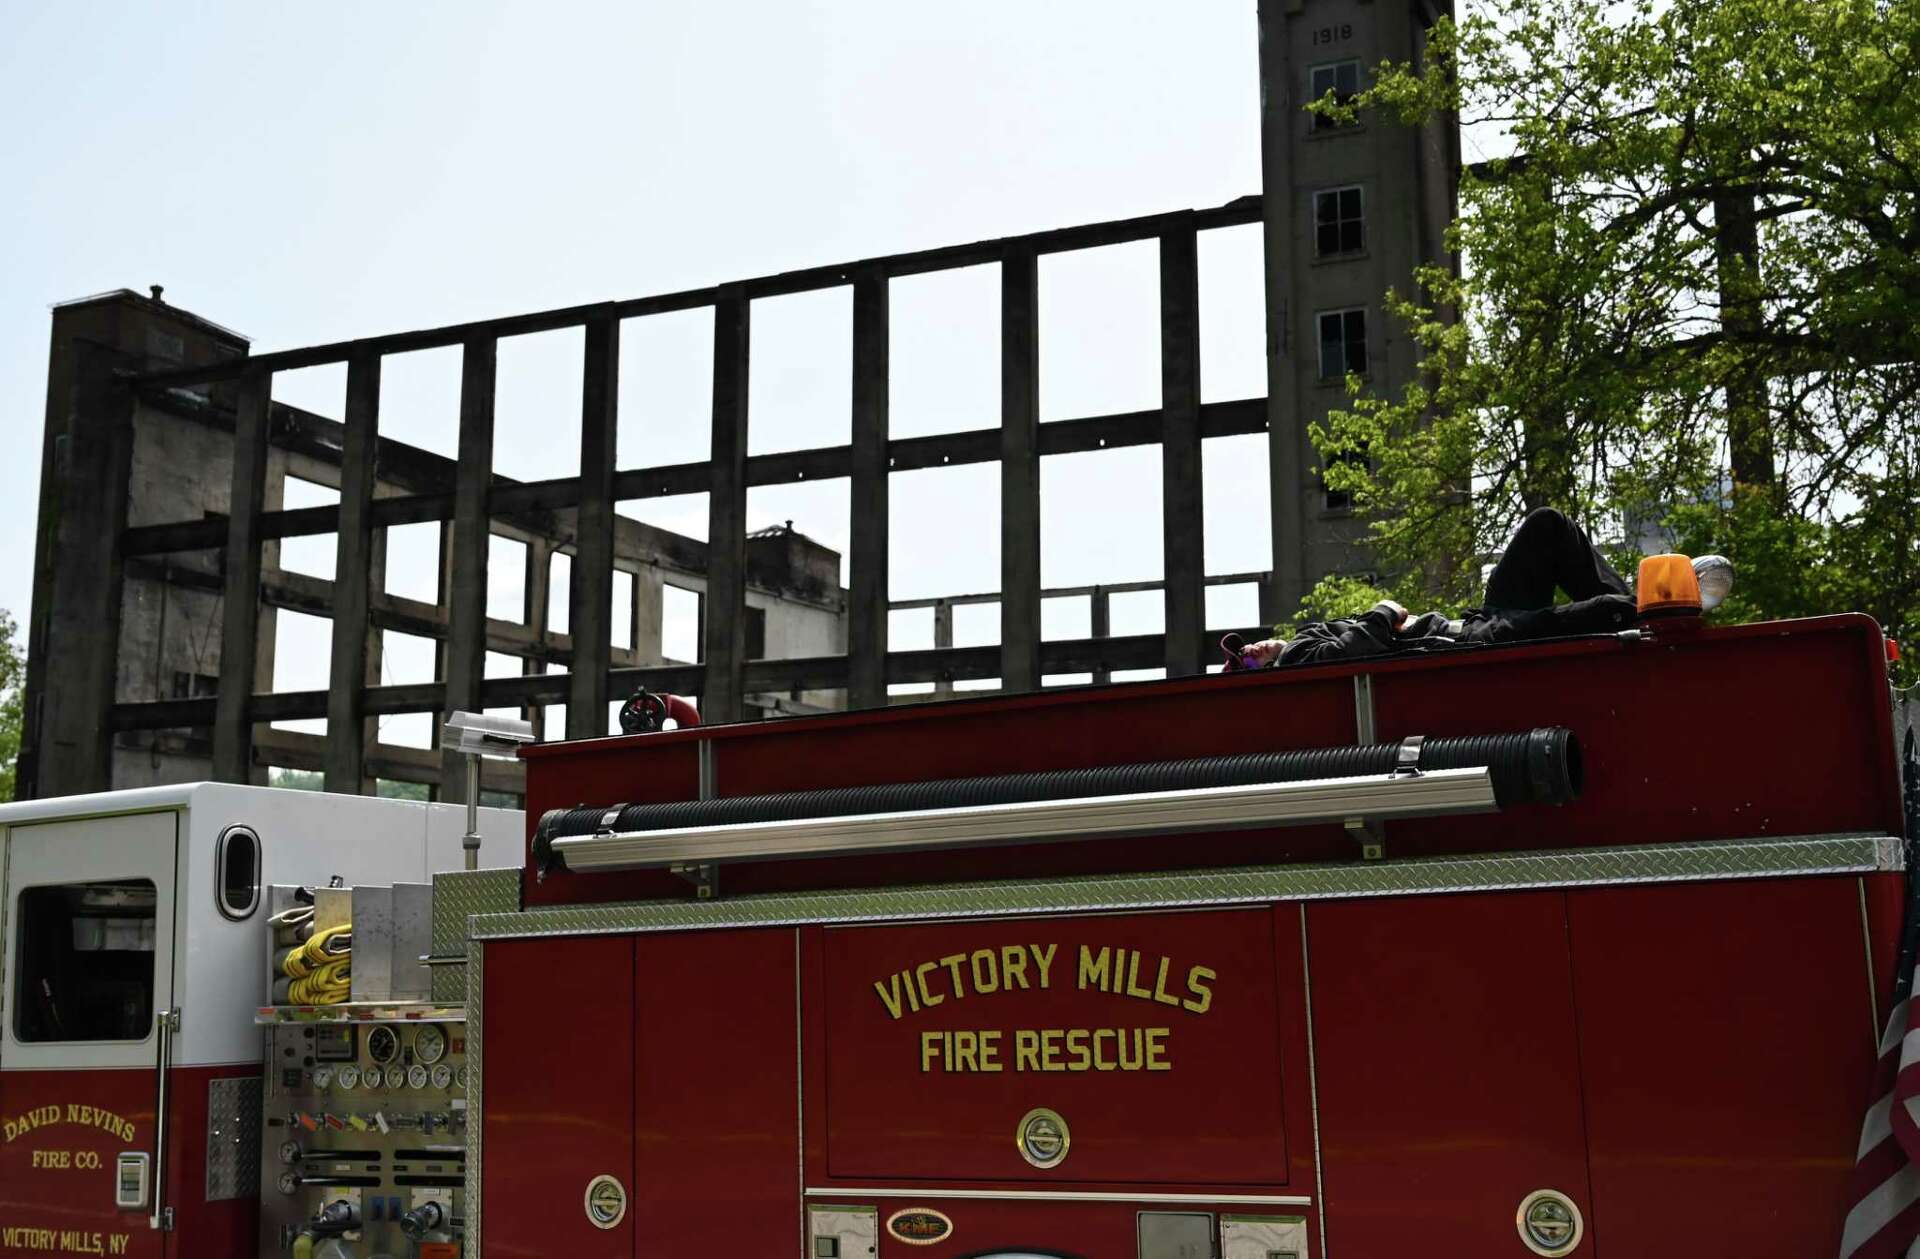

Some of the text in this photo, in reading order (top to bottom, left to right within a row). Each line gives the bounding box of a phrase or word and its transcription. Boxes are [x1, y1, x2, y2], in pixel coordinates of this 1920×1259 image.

[1313, 24, 1352, 46] 1918
[874, 943, 1217, 1020] VICTORY MILLS
[921, 1027, 1172, 1073] FIRE RESCUE
[3, 1103, 136, 1143] DAVID NEVINS
[32, 1150, 103, 1169] FIRE CO.
[2, 1227, 129, 1257] VICTORY MILLS, NY
